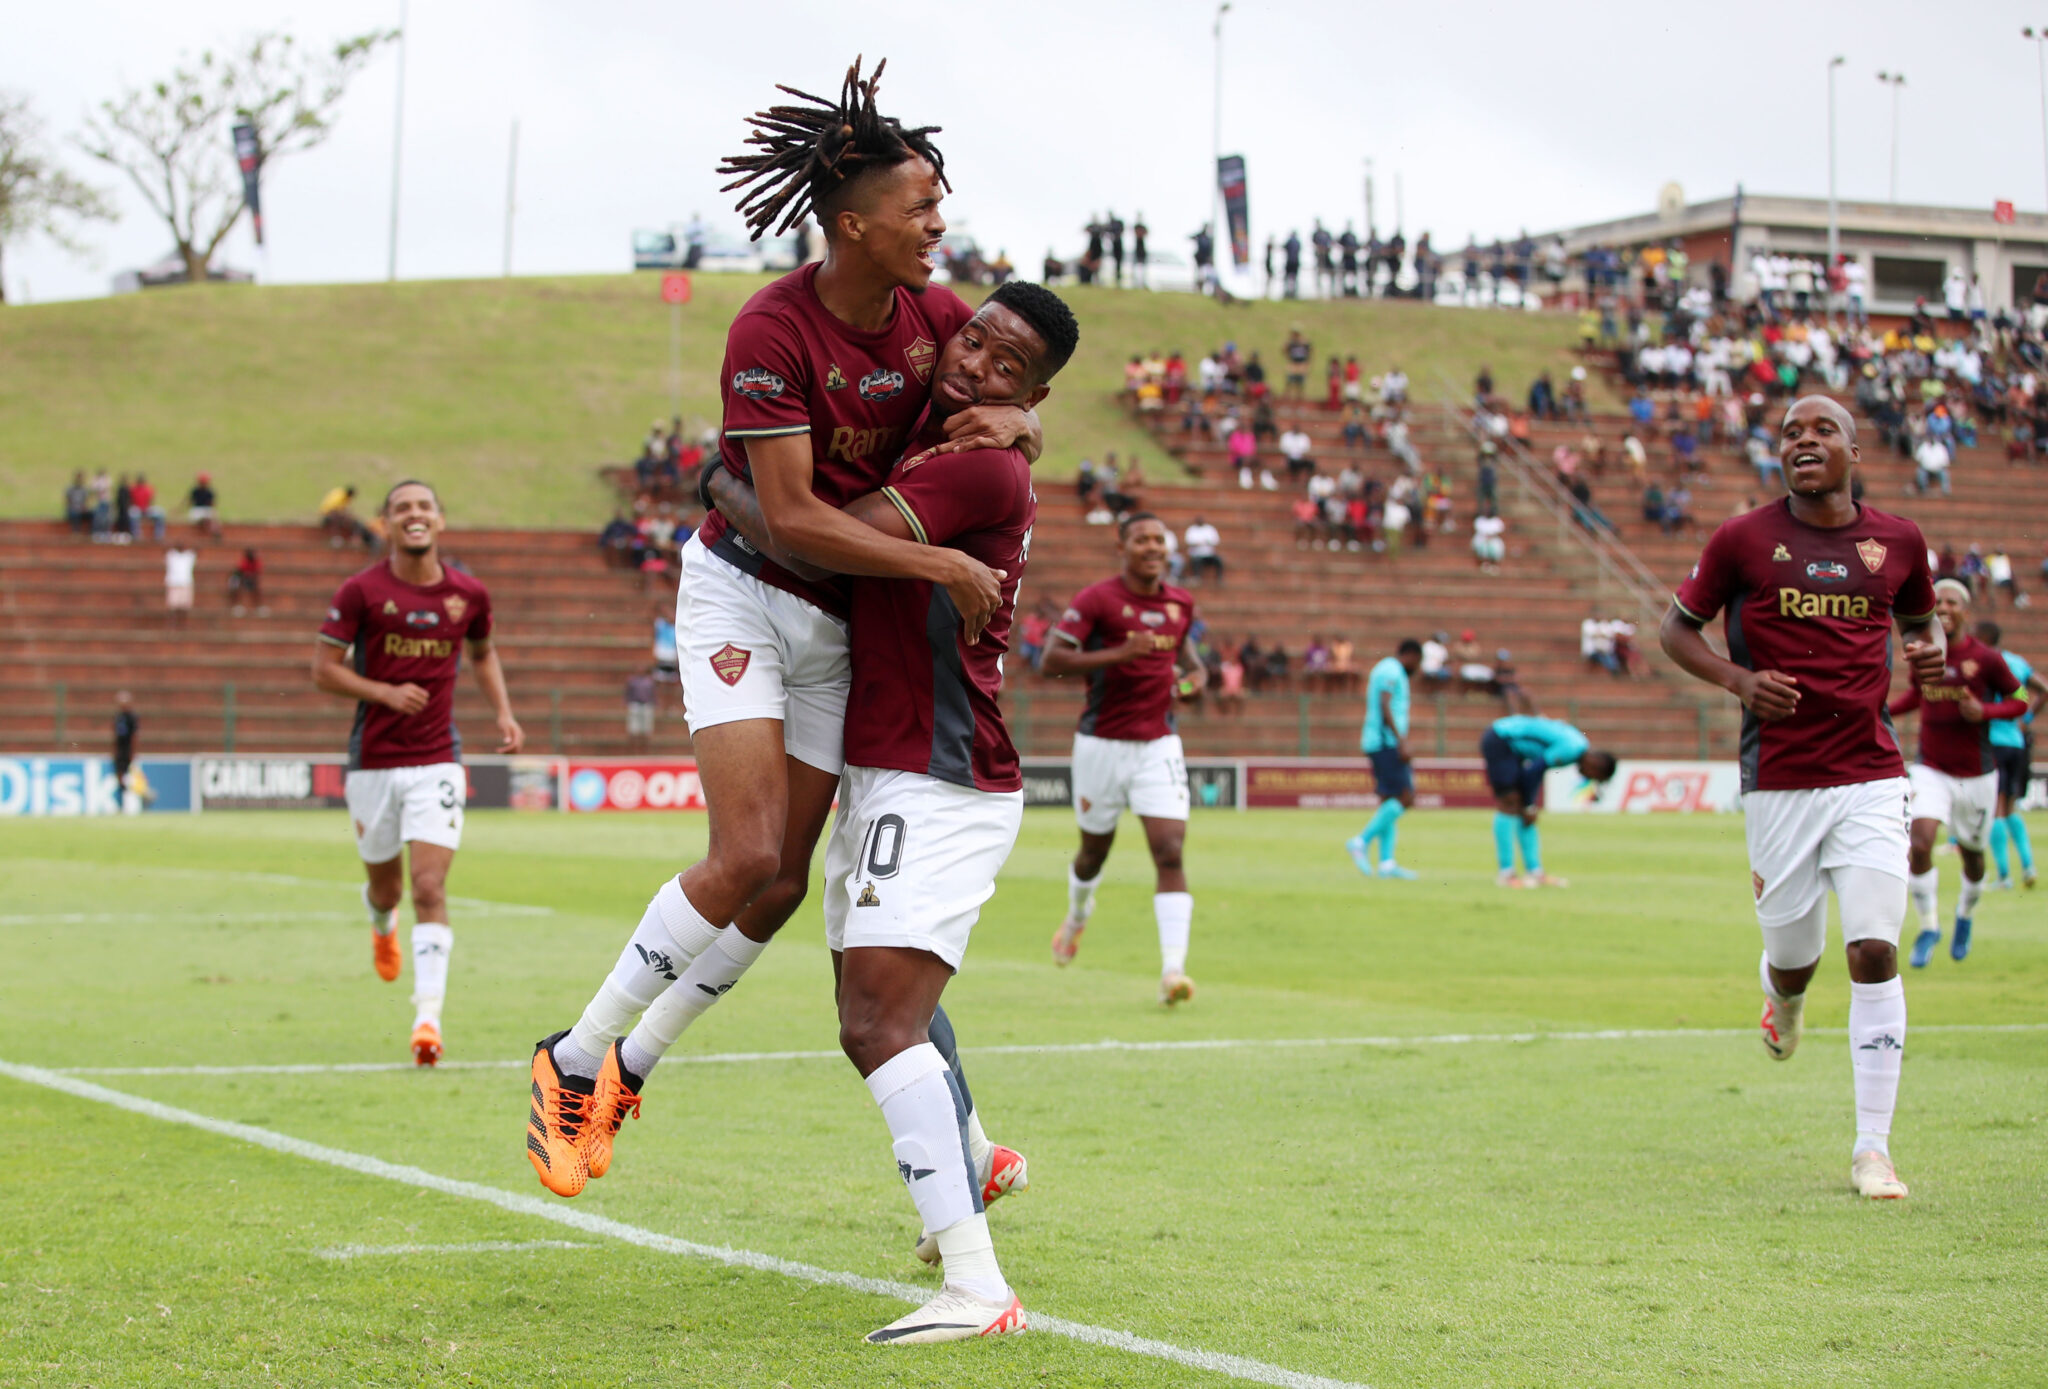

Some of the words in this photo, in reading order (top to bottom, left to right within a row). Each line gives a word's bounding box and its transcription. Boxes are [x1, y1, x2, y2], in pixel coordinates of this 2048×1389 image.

[827, 426, 898, 462] Ram
[1779, 587, 1869, 619] Rama
[384, 633, 452, 658] Rama
[439, 779, 456, 809] 3
[855, 813, 907, 883] 10
